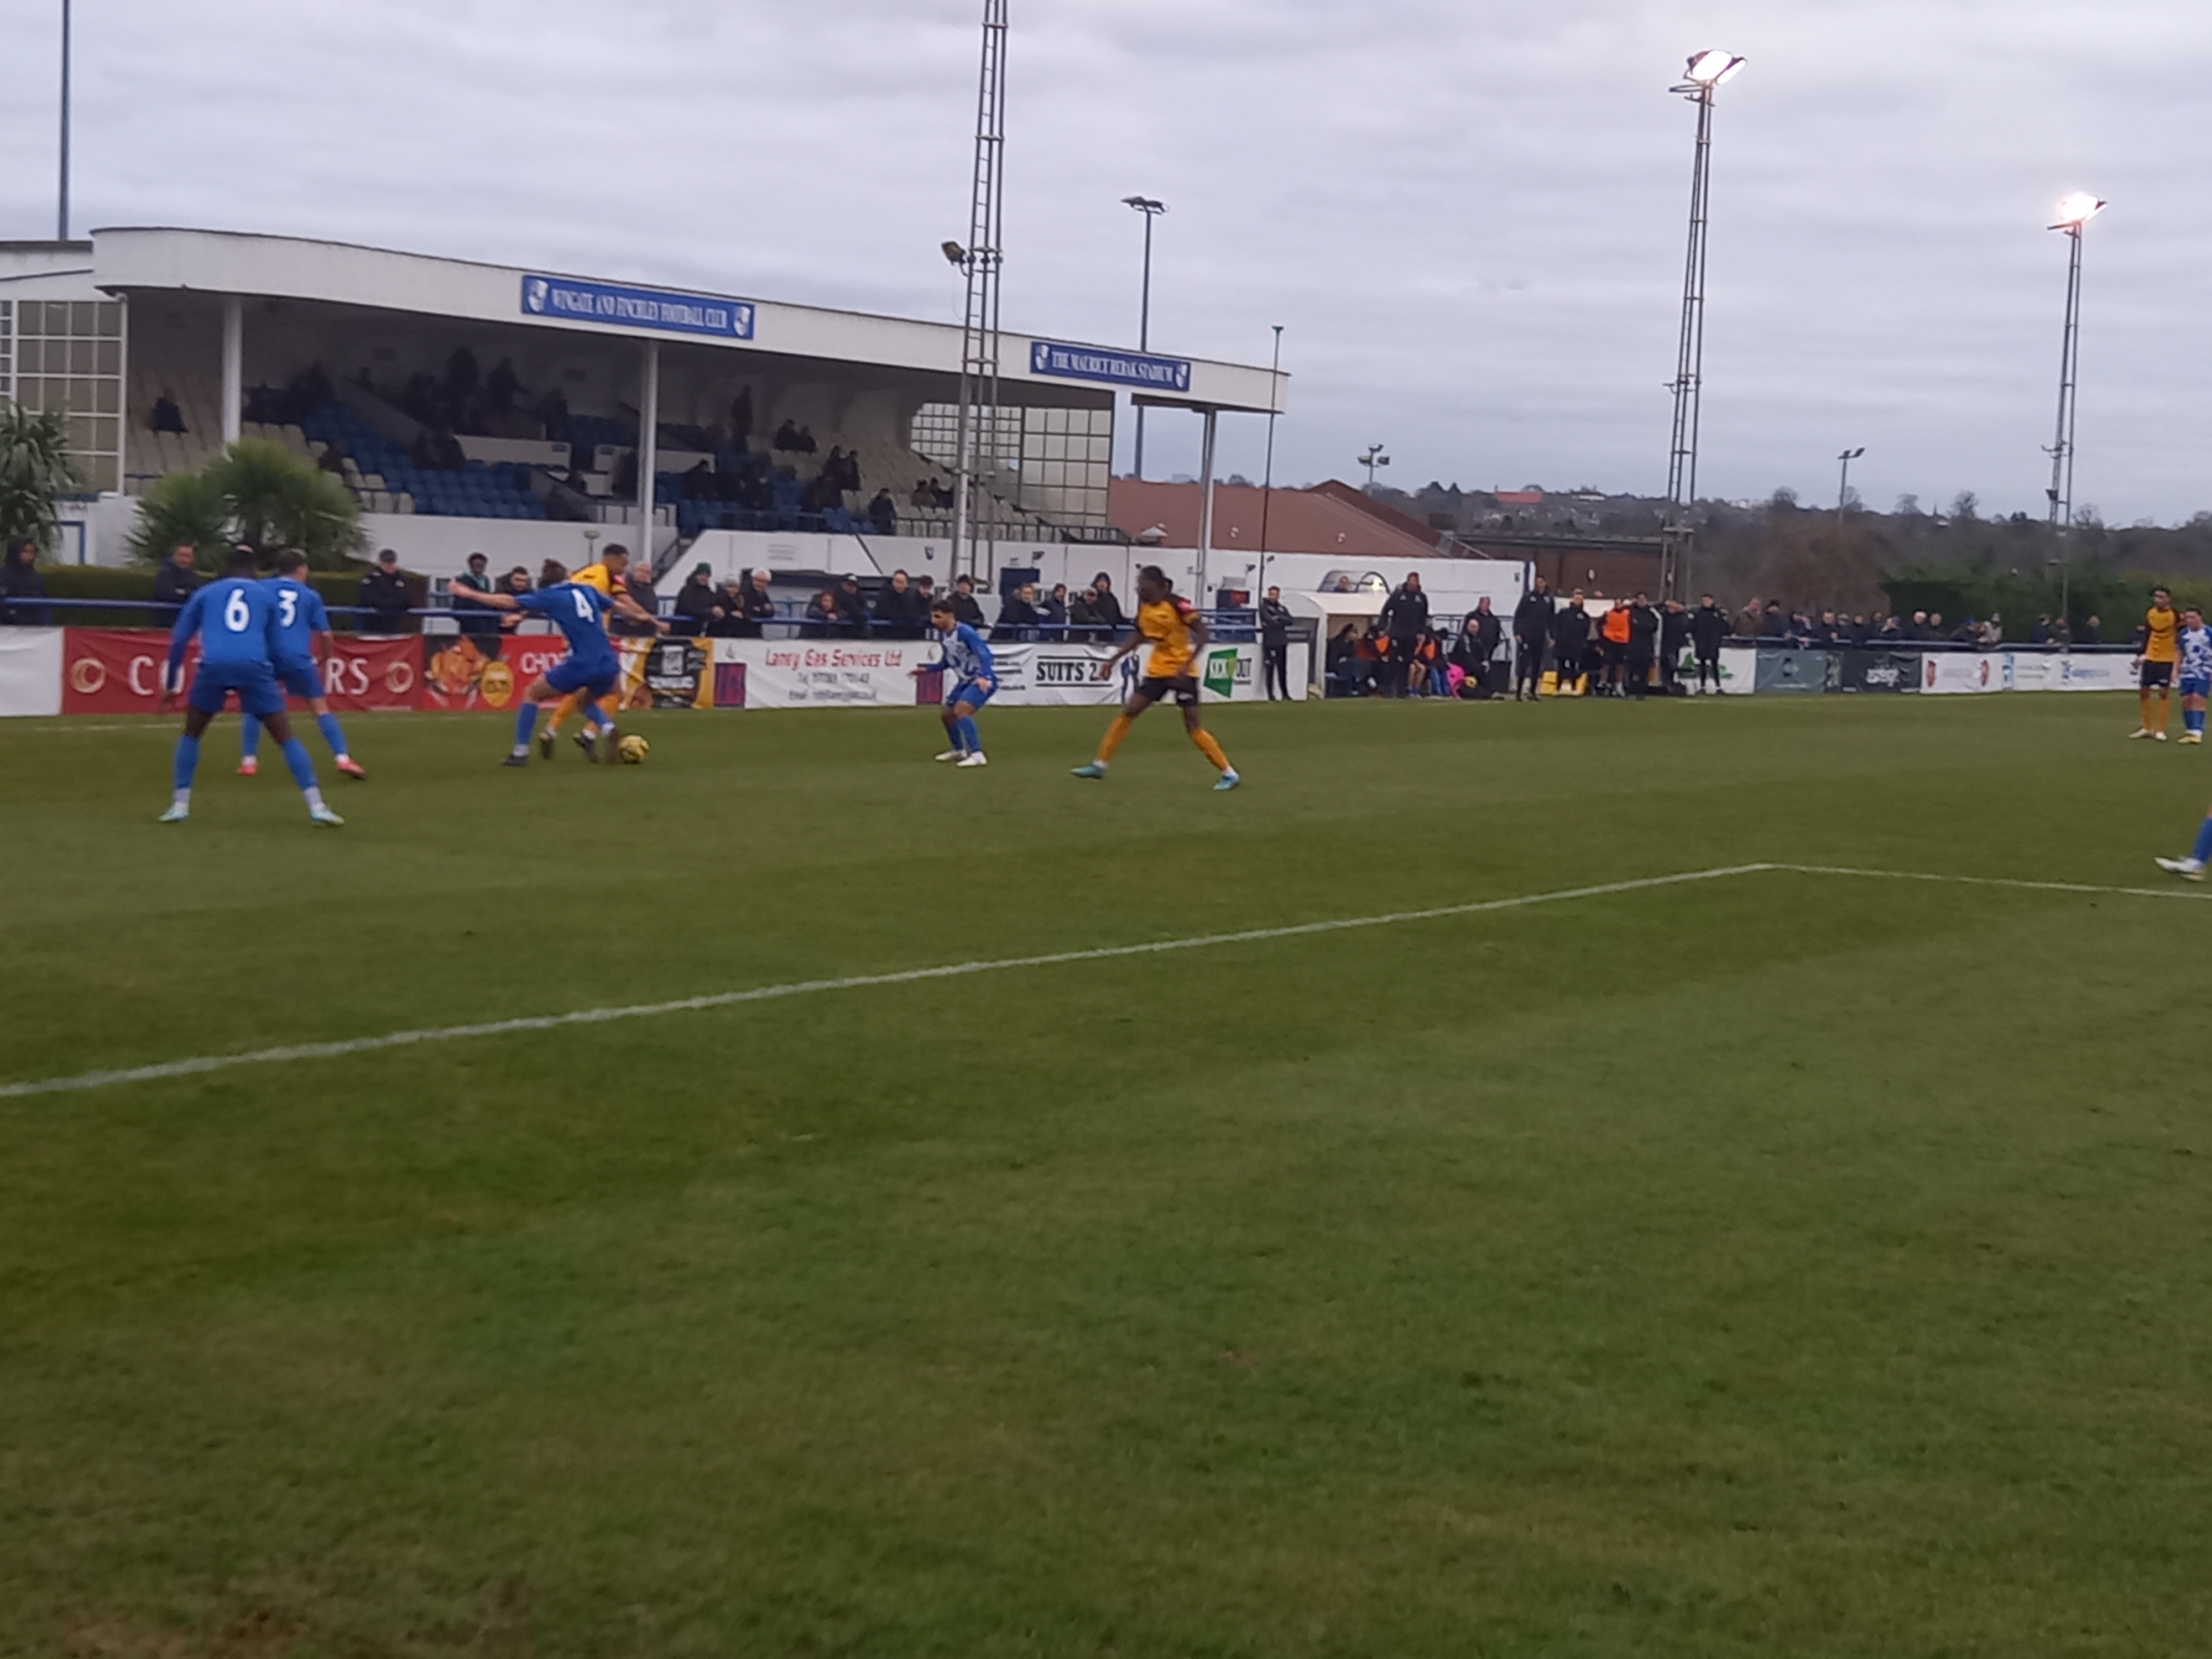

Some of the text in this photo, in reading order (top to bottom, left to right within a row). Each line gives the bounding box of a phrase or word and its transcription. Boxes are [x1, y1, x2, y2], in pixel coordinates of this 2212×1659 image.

[224, 588, 249, 632] 6
[278, 588, 299, 628] 3
[571, 588, 595, 623] 4
[805, 648, 827, 667] Gas
[831, 648, 881, 667] Services
[885, 649, 902, 667] Ltd
[1036, 661, 1085, 681] SUITS
